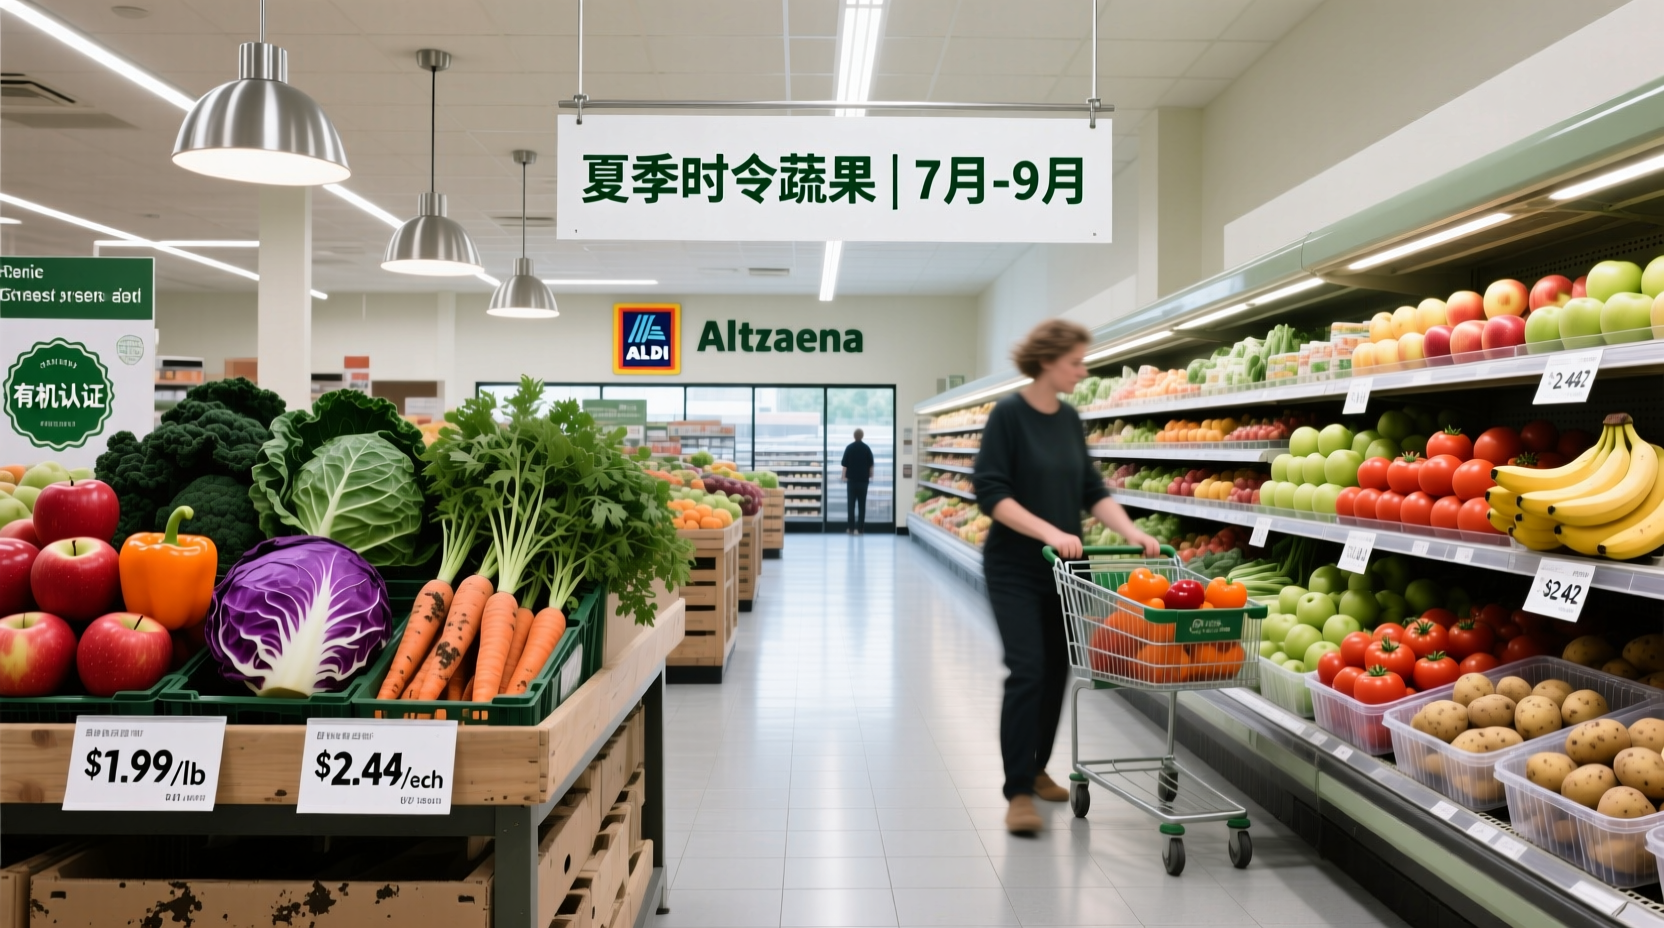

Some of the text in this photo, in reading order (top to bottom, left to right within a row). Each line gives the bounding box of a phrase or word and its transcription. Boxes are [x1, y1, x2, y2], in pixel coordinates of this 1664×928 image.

[581, 152, 877, 205] 夏季时令蔬果
[915, 156, 1085, 205] 7月-9月
[626, 345, 669, 361] ALDI
[697, 319, 864, 353] Altzaena
[13, 382, 105, 410] 有机认证
[84, 747, 206, 787] $1.99/lb
